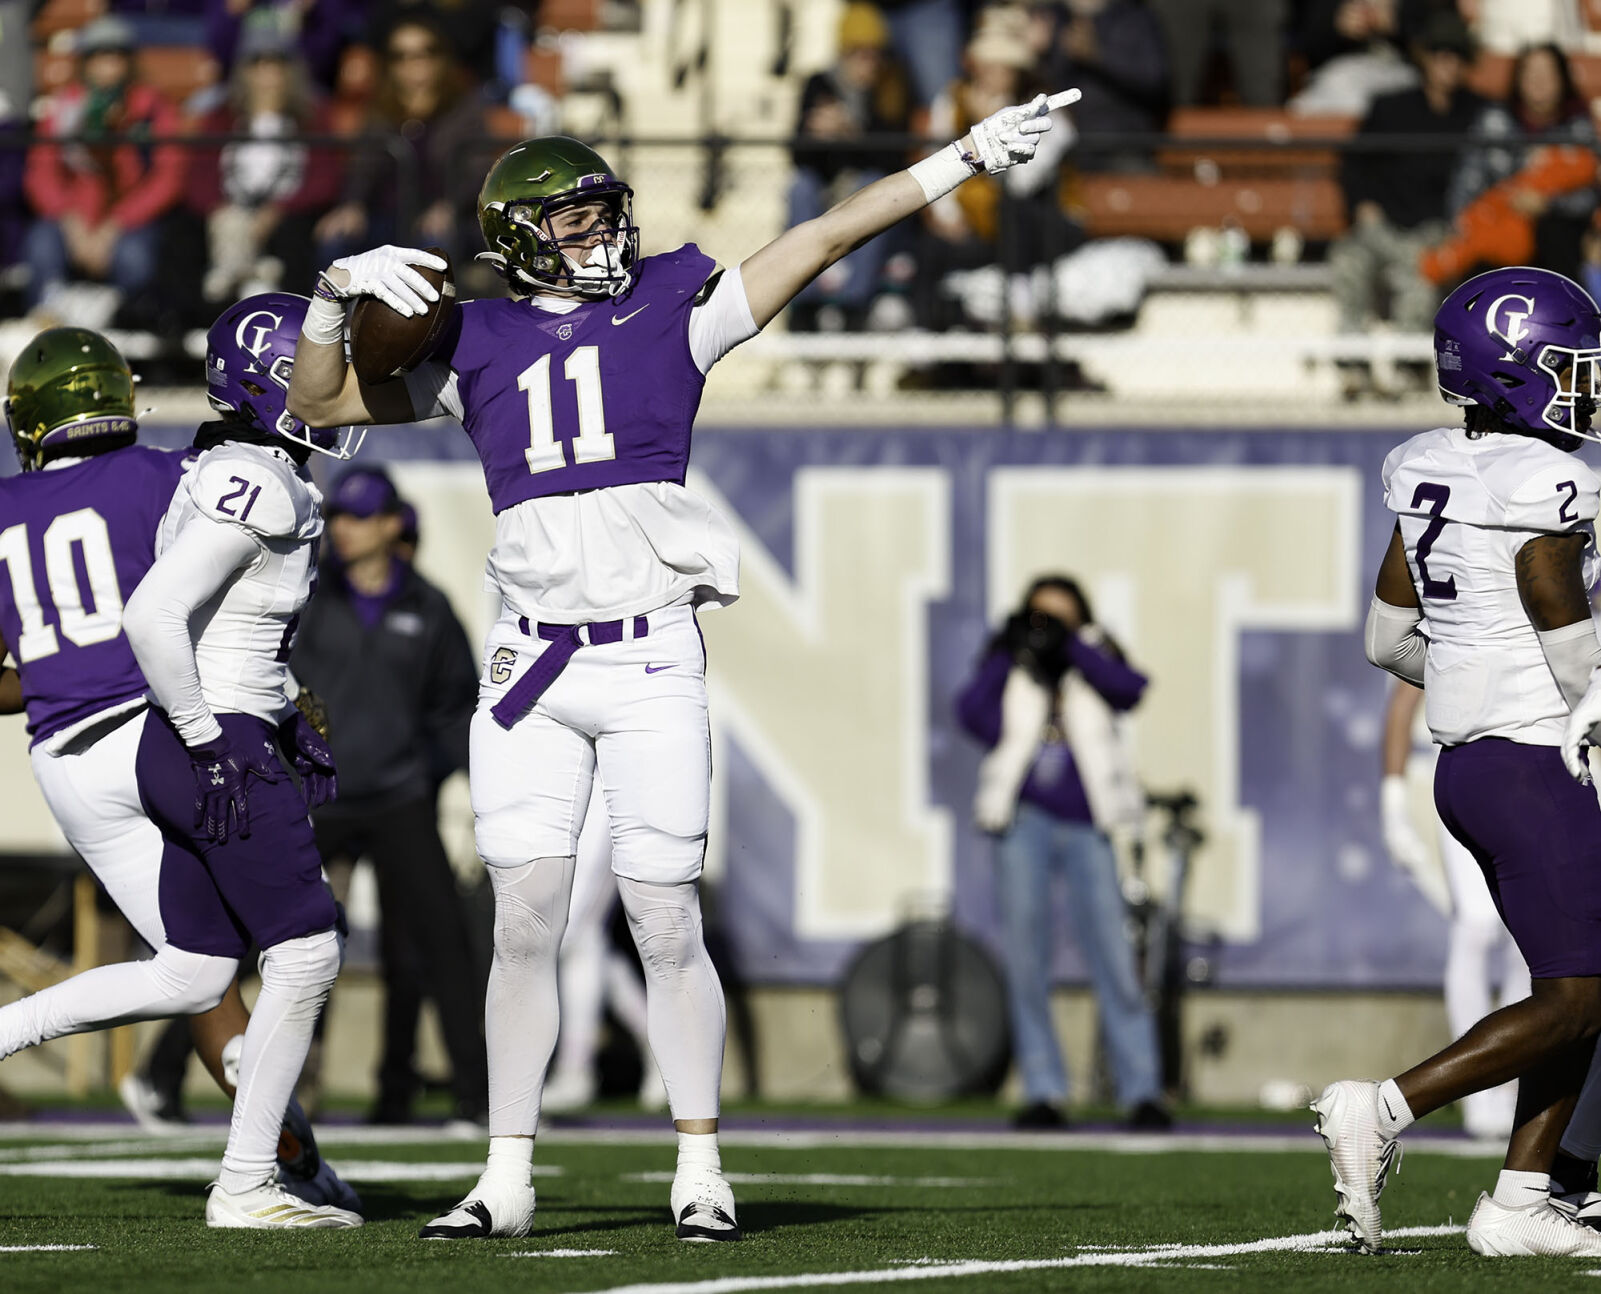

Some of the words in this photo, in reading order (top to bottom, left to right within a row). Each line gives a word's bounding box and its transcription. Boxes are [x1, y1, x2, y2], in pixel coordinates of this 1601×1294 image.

[67, 421, 109, 439] SAINTS
[517, 346, 616, 475] 11
[215, 475, 263, 523] 21
[1555, 480, 1579, 523] 2
[1410, 482, 1458, 601] 2
[0, 507, 124, 665] 10
